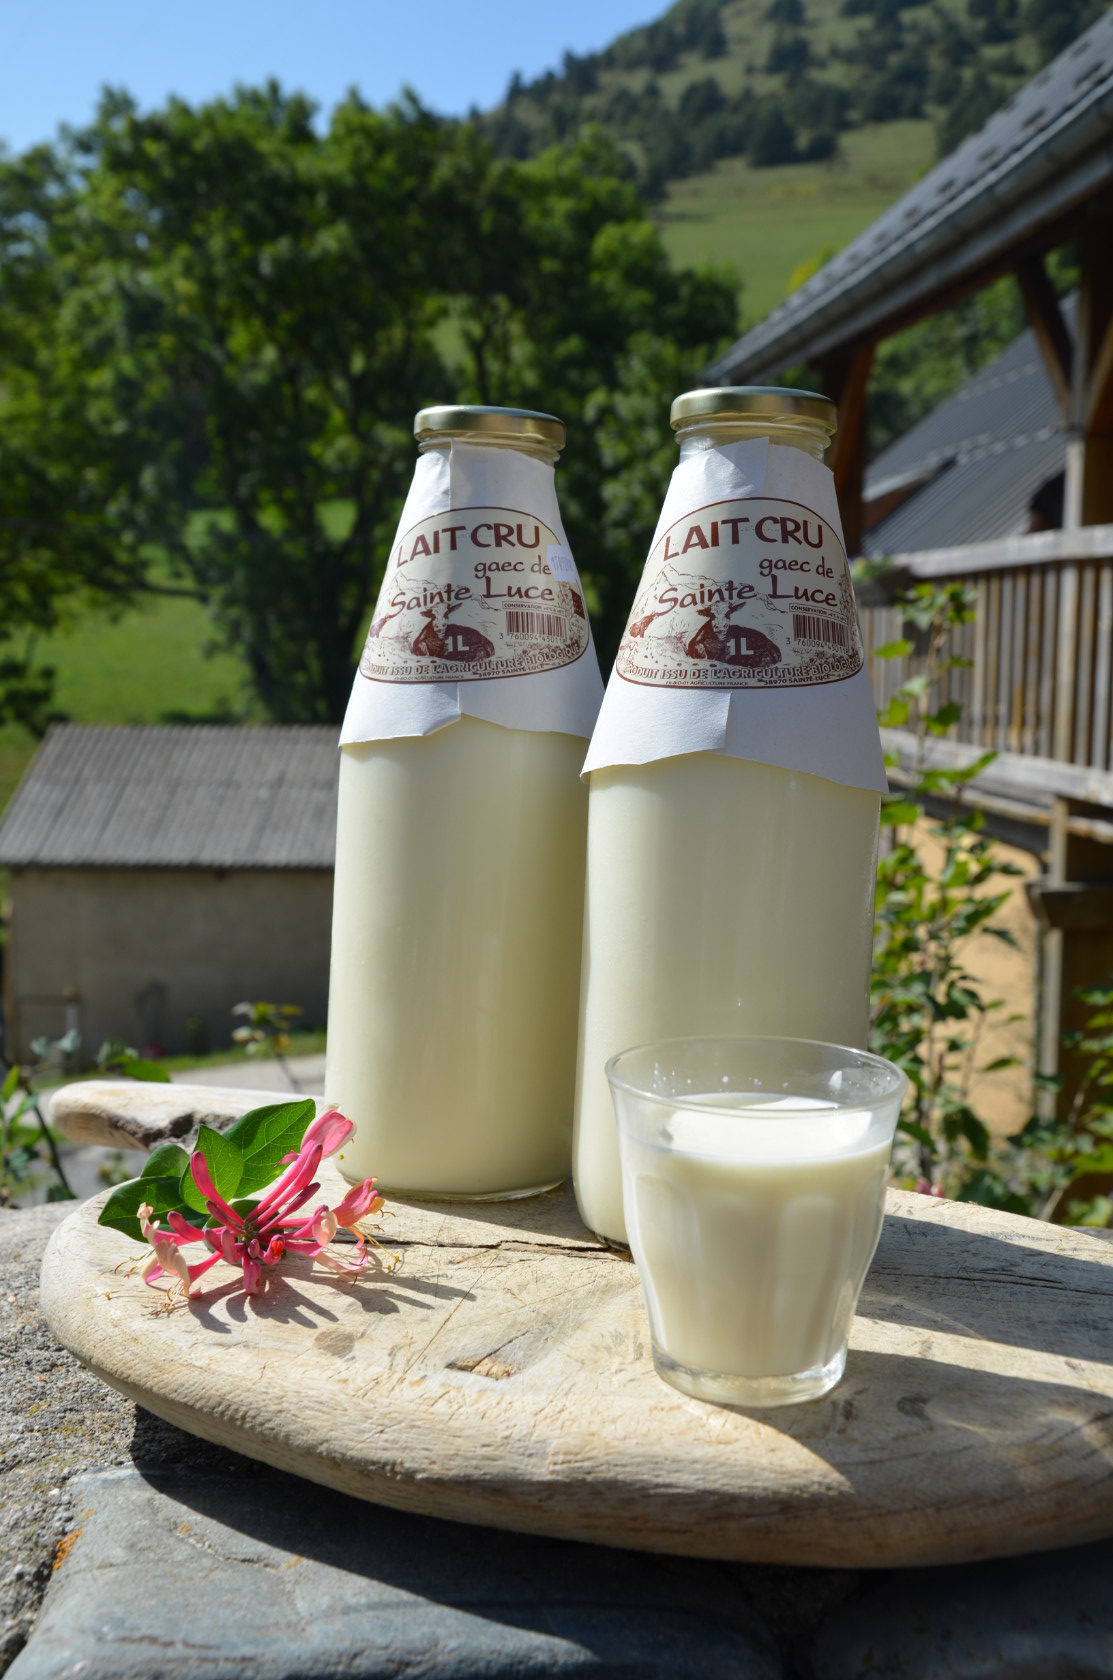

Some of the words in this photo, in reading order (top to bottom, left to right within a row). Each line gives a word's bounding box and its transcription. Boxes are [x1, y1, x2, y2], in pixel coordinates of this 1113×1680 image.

[397, 525, 467, 568] LAIT
[471, 522, 540, 549] CRU
[663, 517, 750, 562] LAIT
[755, 515, 823, 549] CRU
[474, 561, 526, 580] gaec
[530, 554, 552, 575] de
[759, 556, 811, 577] gaec
[816, 555, 835, 579] de
[391, 583, 473, 616] Sainte
[482, 576, 555, 602] Luce
[656, 580, 756, 616] Sainte
[767, 573, 838, 606] Luce
[391, 665, 413, 676] ISSU
[415, 664, 430, 675] DE
[432, 656, 524, 675] L'AGRICULTURE
[524, 641, 580, 666] BIOLOGIQUE
[445, 635, 470, 652] 1L
[726, 637, 754, 656] 1L
[660, 668, 688, 680] ISSU
[690, 668, 709, 680] DE
[711, 666, 811, 680] L'AGRICULTURE
